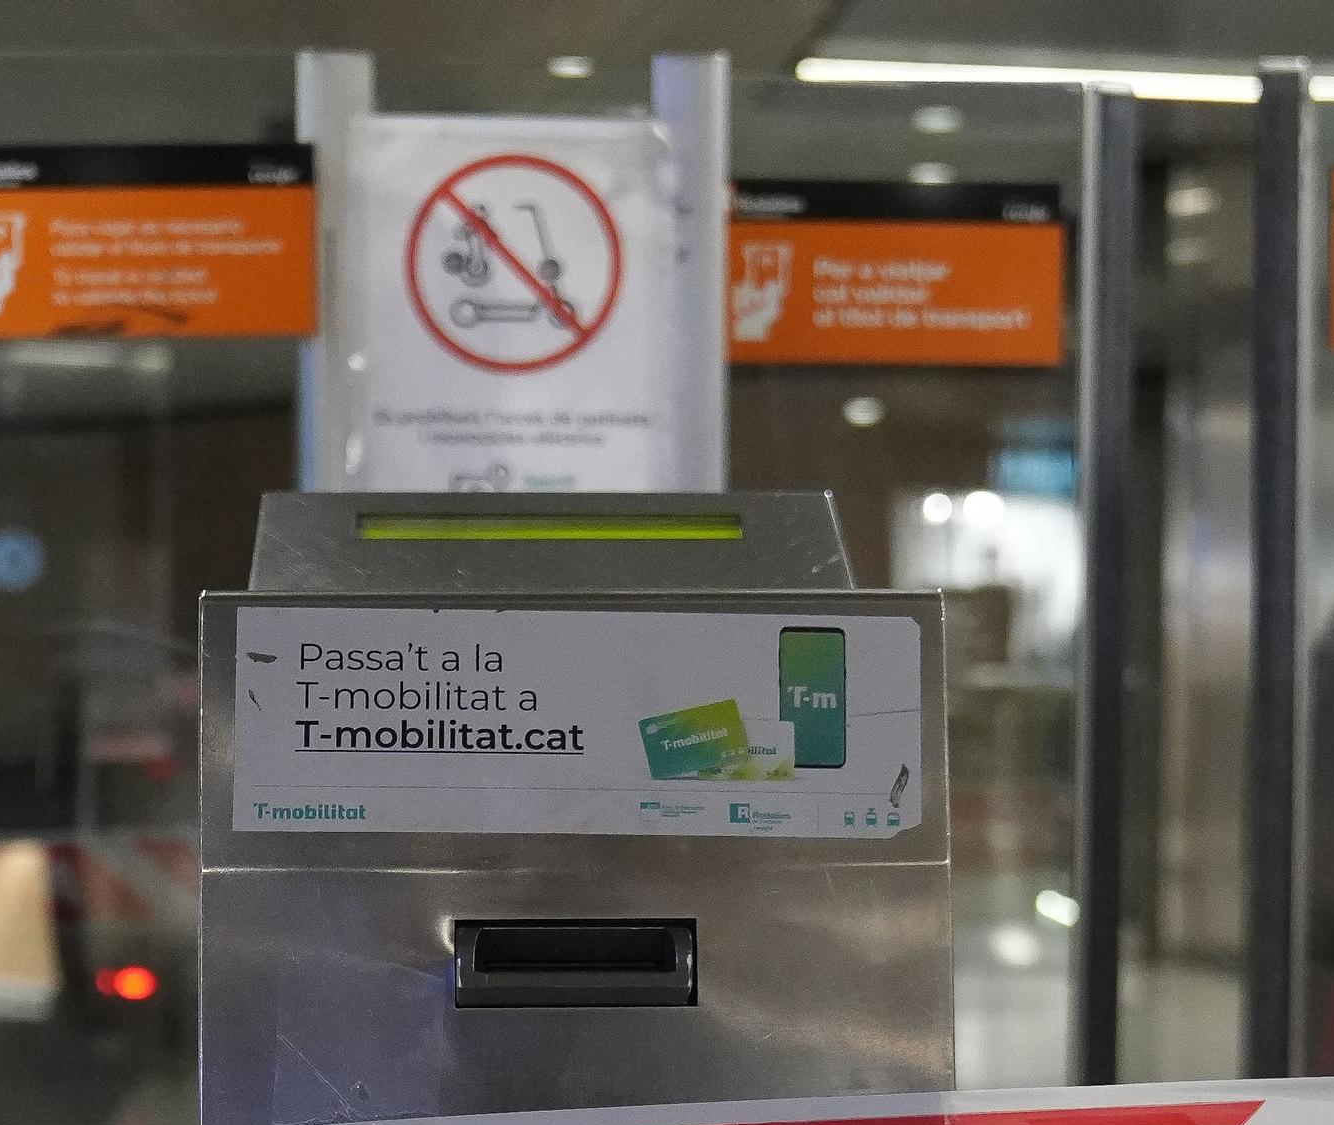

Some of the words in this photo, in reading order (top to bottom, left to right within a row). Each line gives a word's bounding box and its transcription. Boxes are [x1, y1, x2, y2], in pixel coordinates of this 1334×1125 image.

[299, 642, 428, 672] Passa't
[441, 650, 460, 672] a
[475, 643, 503, 673] la
[295, 680, 507, 712] T-mobilitat
[518, 689, 538, 712] a
[786, 685, 837, 709] T-m
[294, 719, 585, 752] T-mobilitat.cat
[660, 727, 729, 751] T-mobilitat
[252, 802, 367, 821] T-mobilitat
